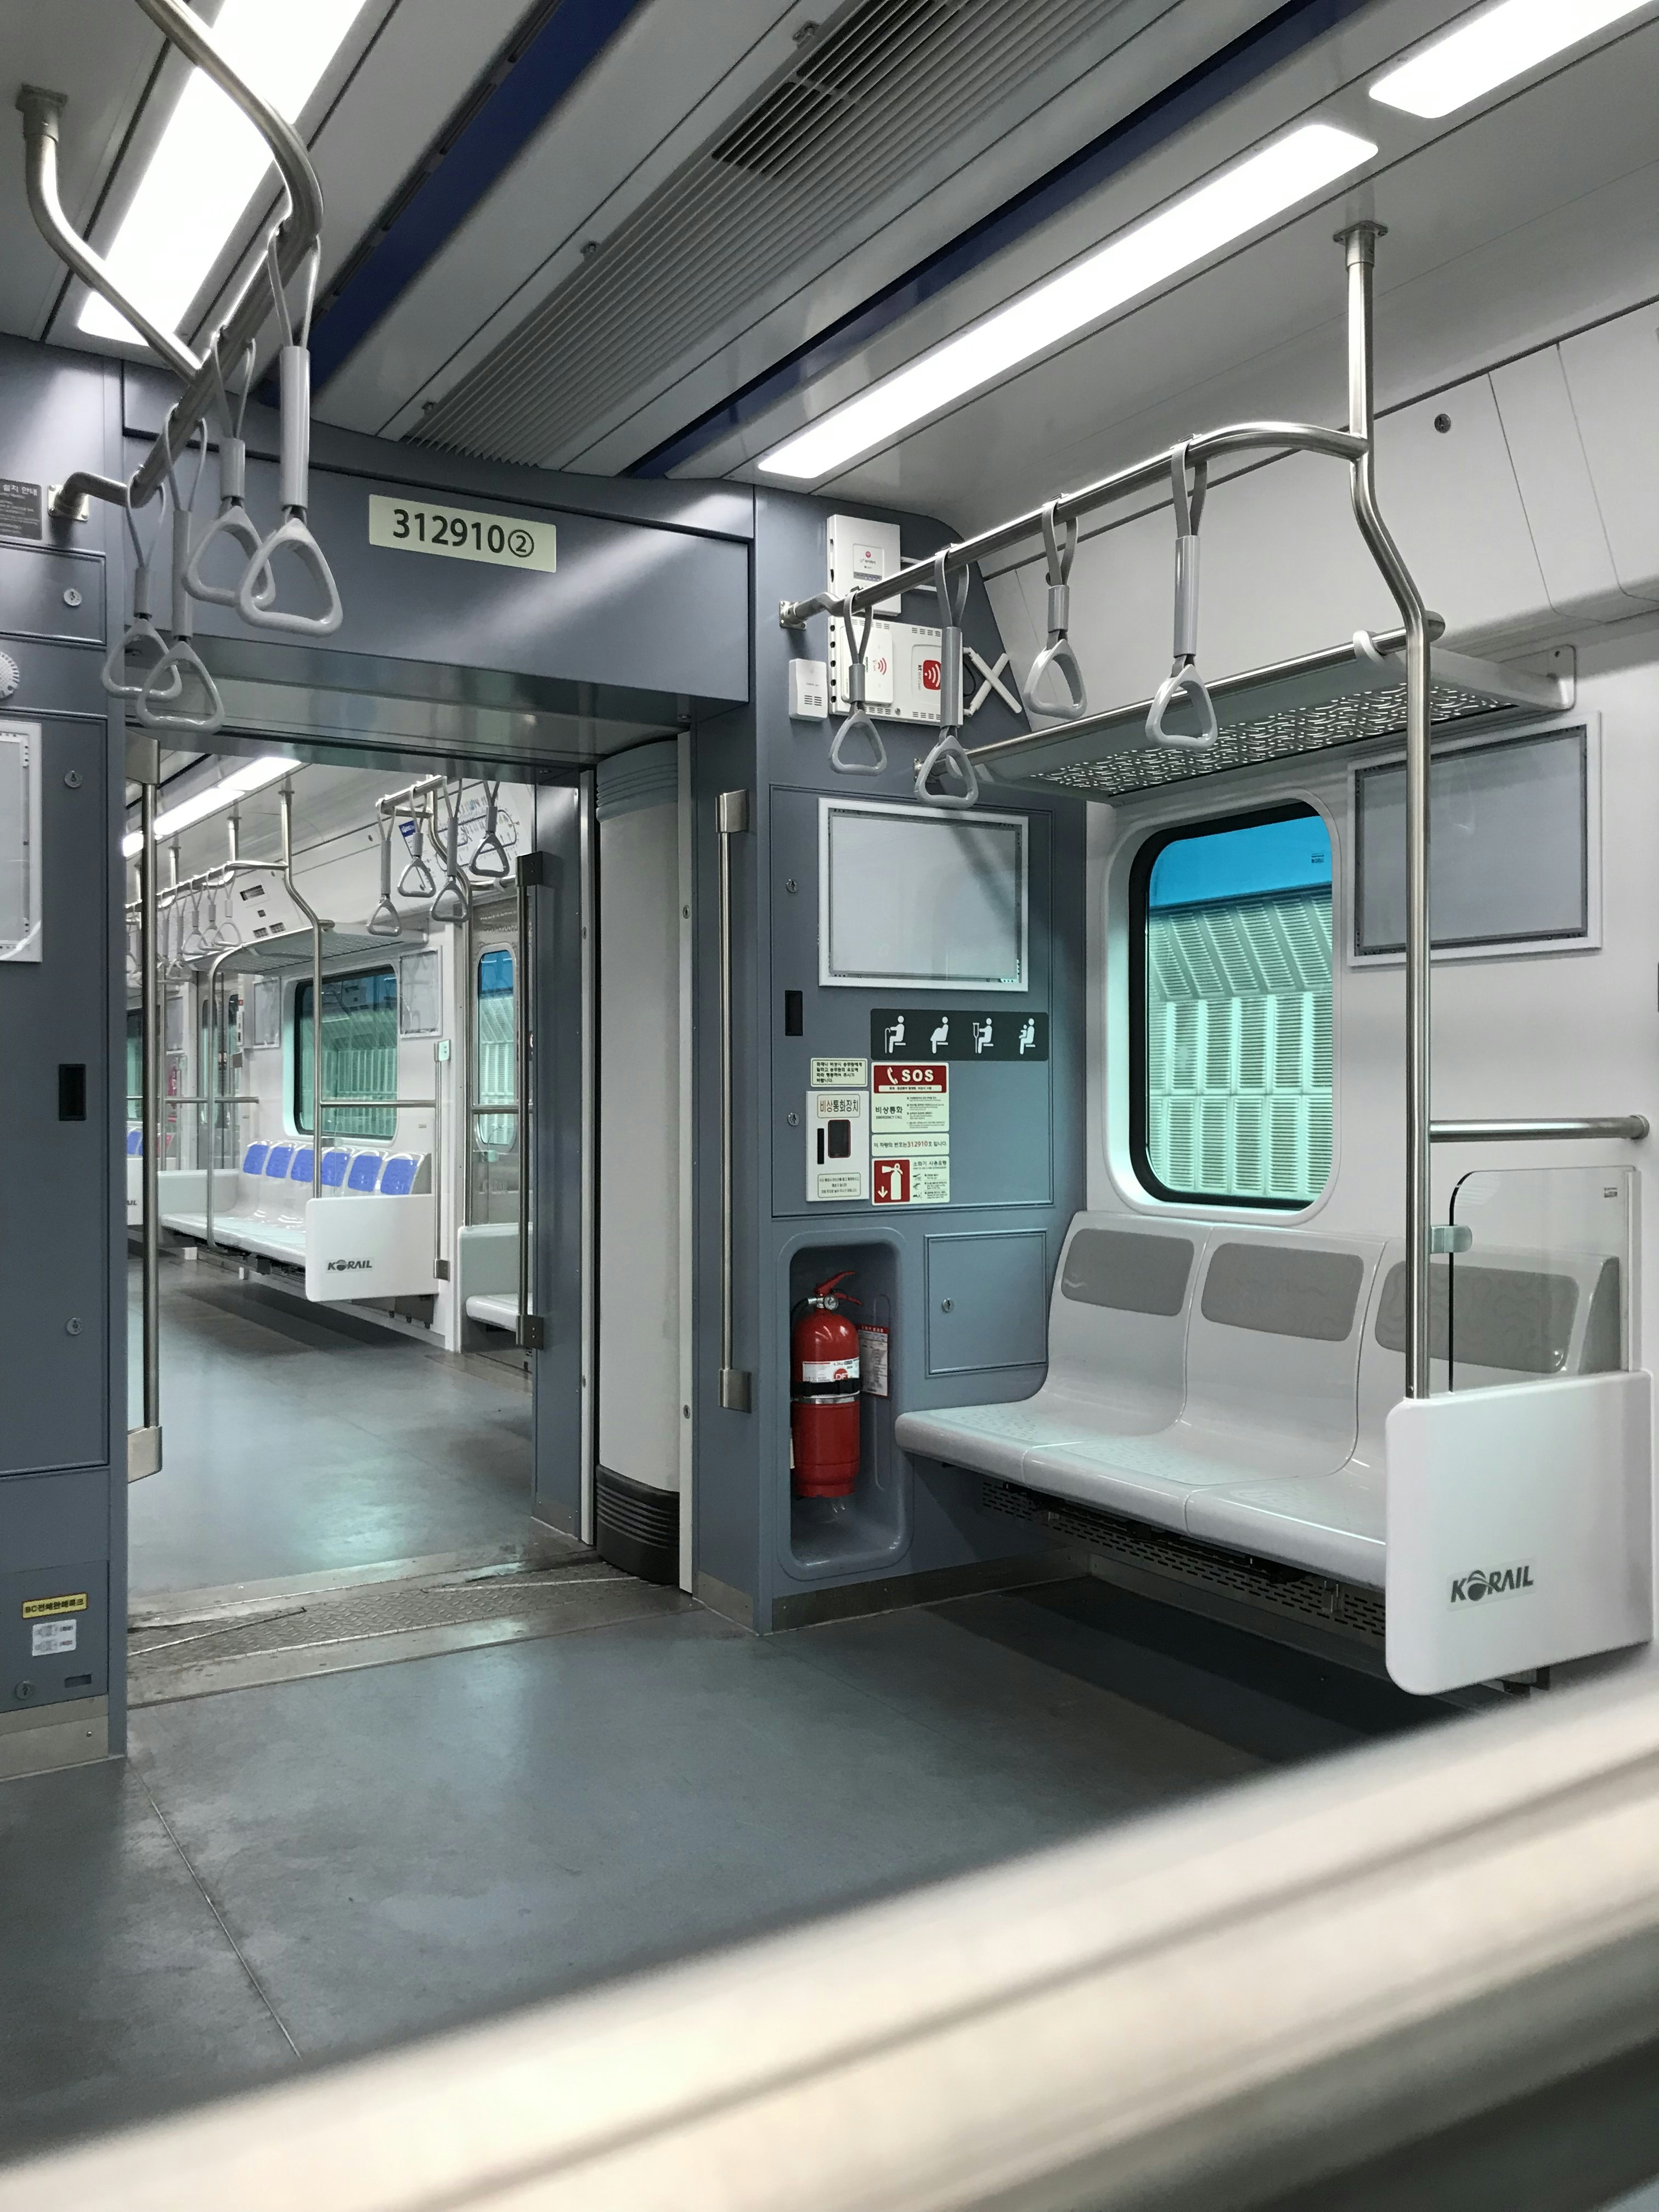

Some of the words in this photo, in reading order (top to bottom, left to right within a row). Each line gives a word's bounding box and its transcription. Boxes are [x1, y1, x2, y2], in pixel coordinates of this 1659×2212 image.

[901, 1069, 934, 1082] SOS
[820, 1099, 858, 1113] 비상통화장치
[875, 1106, 903, 1114] 비상통화
[327, 1260, 373, 1271] KORAIL
[1451, 1565, 1534, 1603] KORAIL
